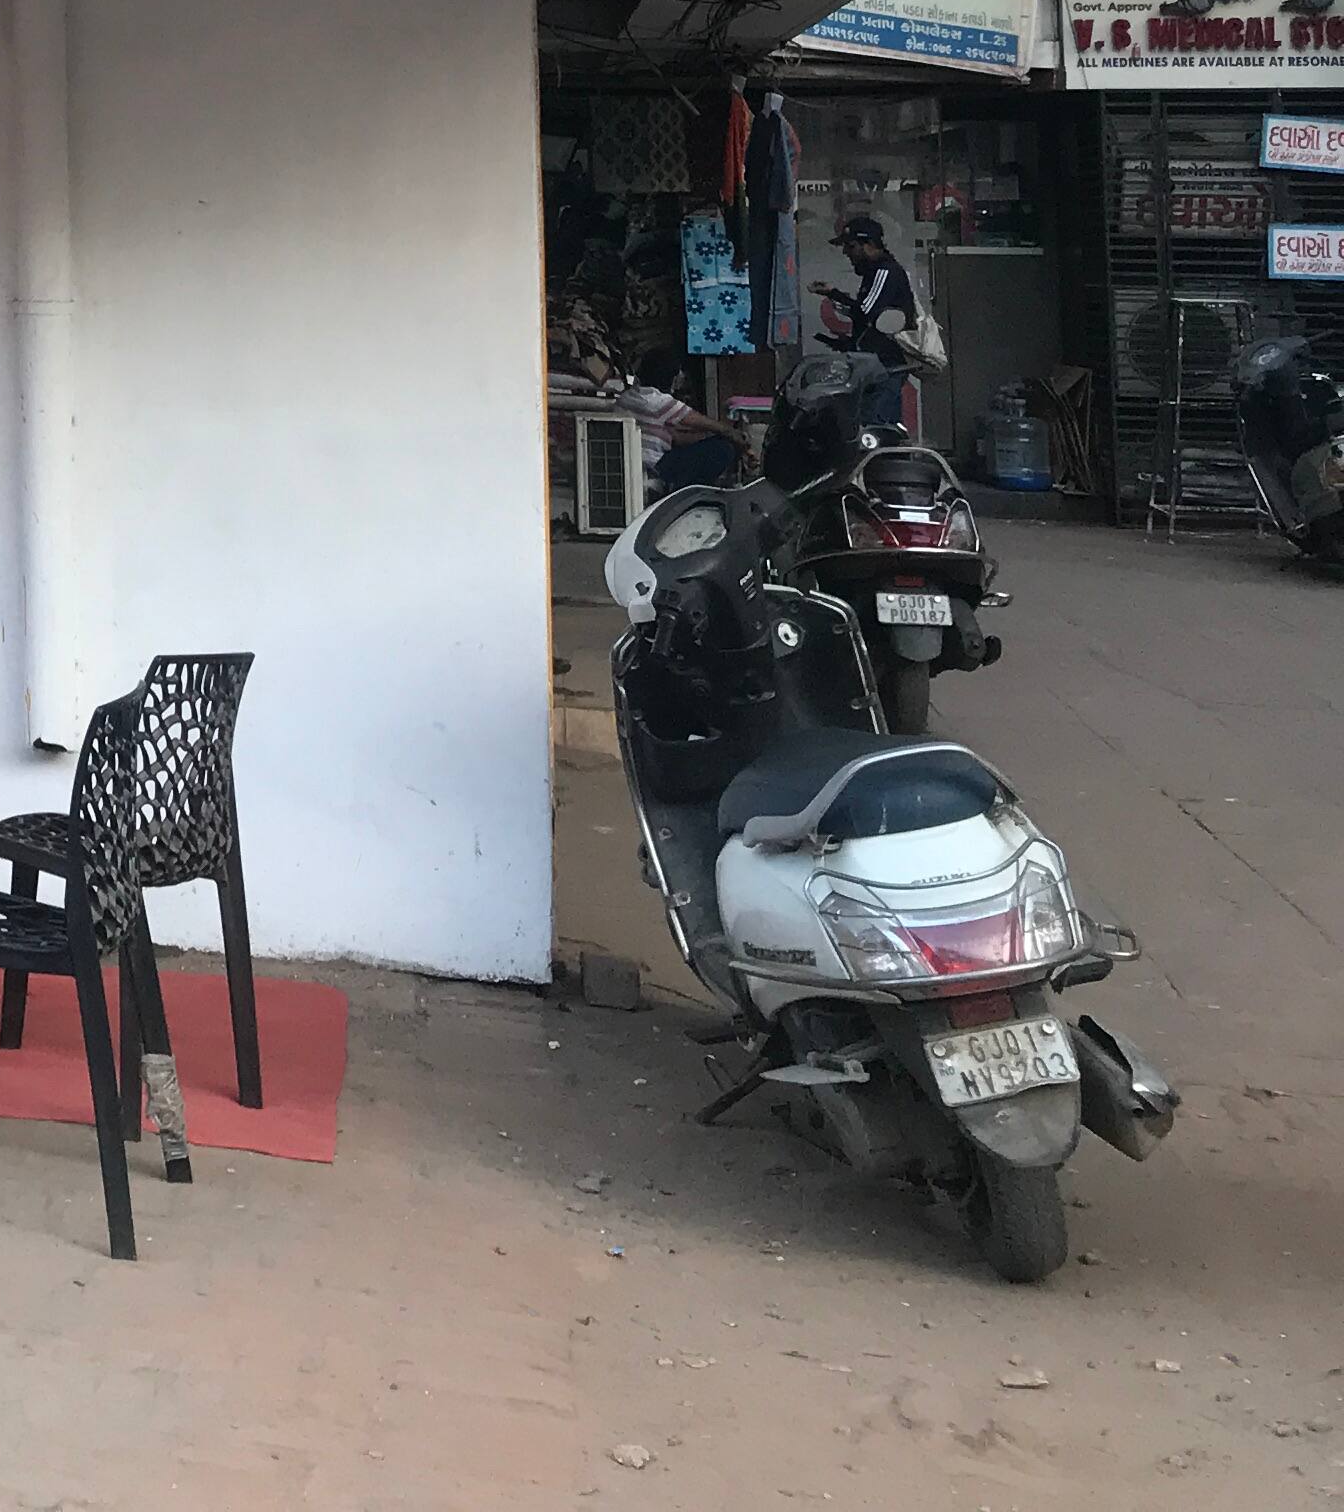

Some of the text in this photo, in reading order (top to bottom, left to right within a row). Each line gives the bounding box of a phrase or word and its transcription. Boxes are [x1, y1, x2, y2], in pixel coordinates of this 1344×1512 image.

[1072, 2, 1105, 13] Govt.
[1146, 16, 1282, 51] MEDICAL
[1077, 57, 1099, 68] ALL
[1101, 56, 1168, 68] MEDICINES
[1172, 56, 1195, 68] ARE
[1198, 56, 1265, 68] AVAILABLE
[1268, 56, 1285, 67] AT
[898, 594, 935, 610] GJ01
[968, 1025, 1039, 1063] GJ01
